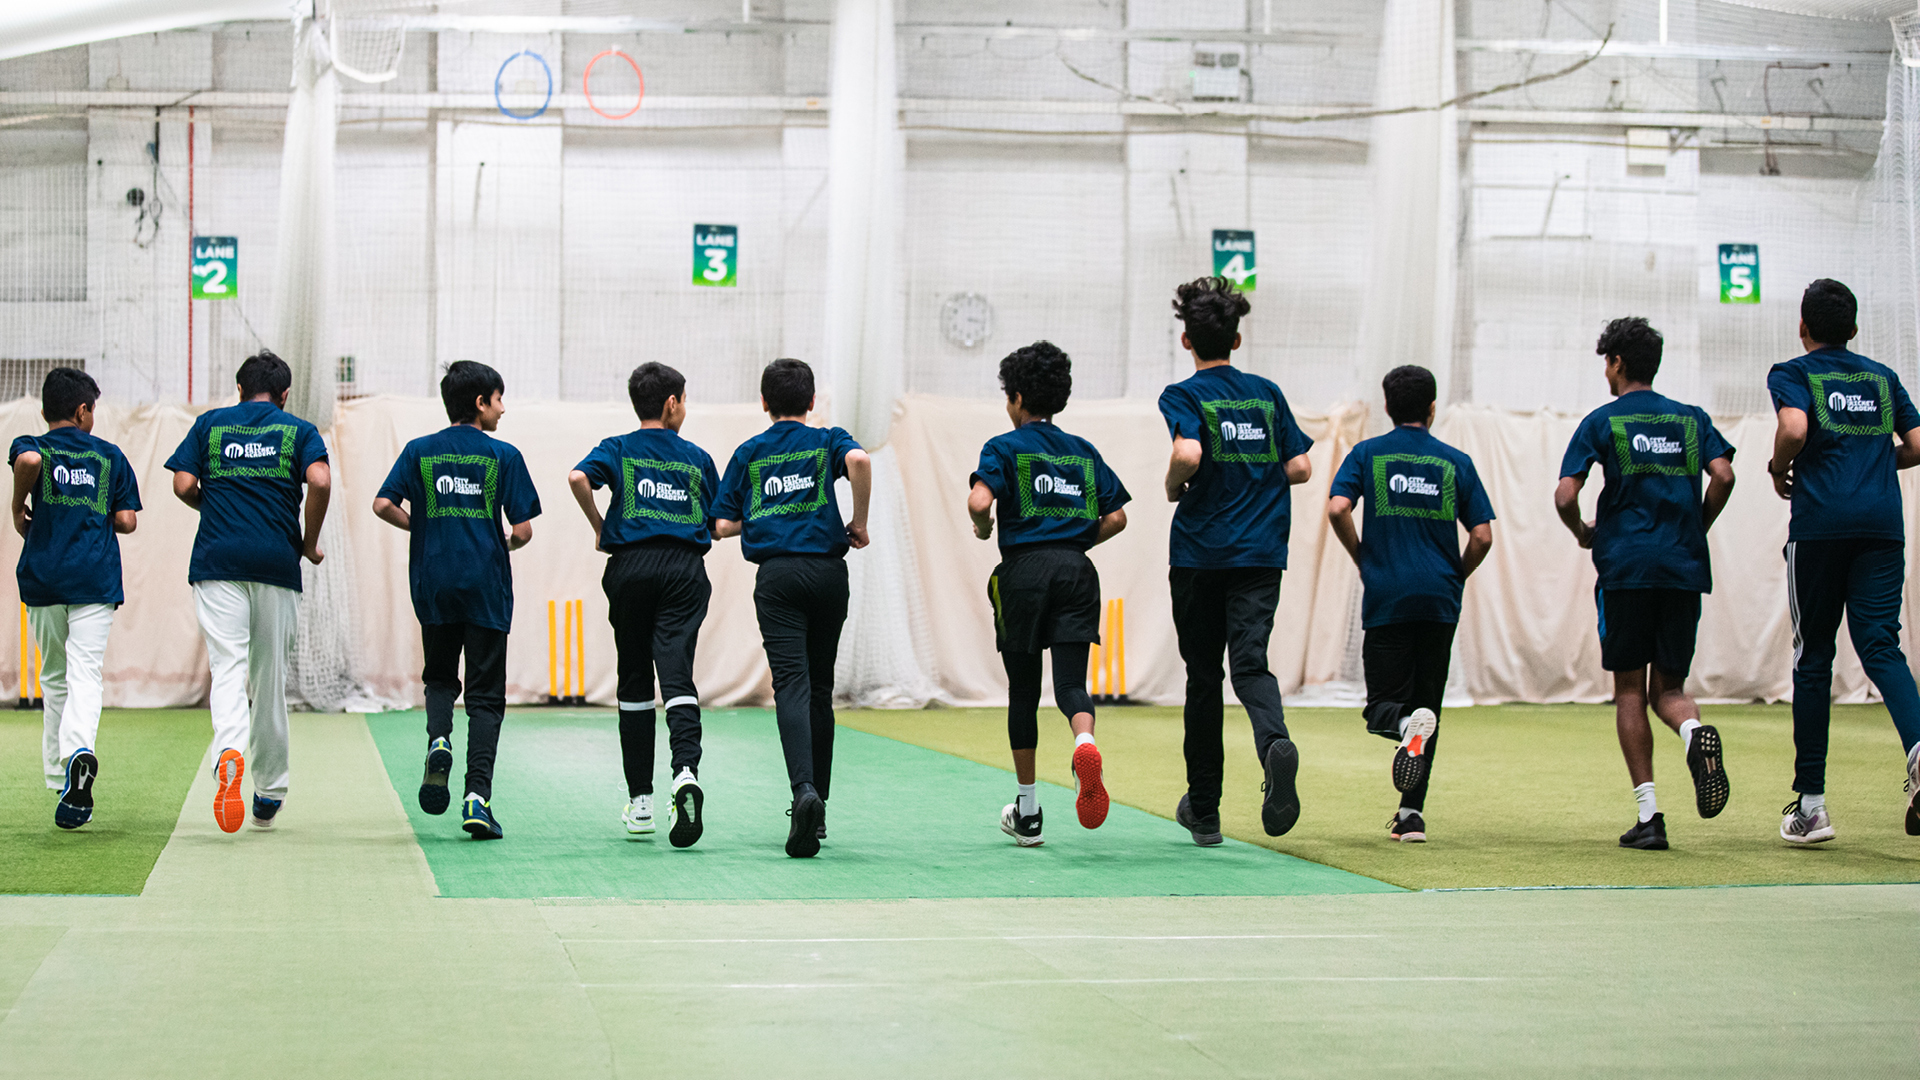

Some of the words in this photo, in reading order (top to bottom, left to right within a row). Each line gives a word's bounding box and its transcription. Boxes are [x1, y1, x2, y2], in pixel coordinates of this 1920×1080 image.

[696, 233, 735, 247] LANE
[1215, 240, 1252, 253] LANE
[197, 246, 235, 259] LANE
[1720, 252, 1757, 266] LANE
[703, 248, 728, 281] 3
[1221, 253, 1246, 285] 4
[202, 260, 227, 293] 2
[1729, 266, 1753, 297] 5
[783, 473, 799, 482] CITY
[656, 482, 673, 490] CITY
